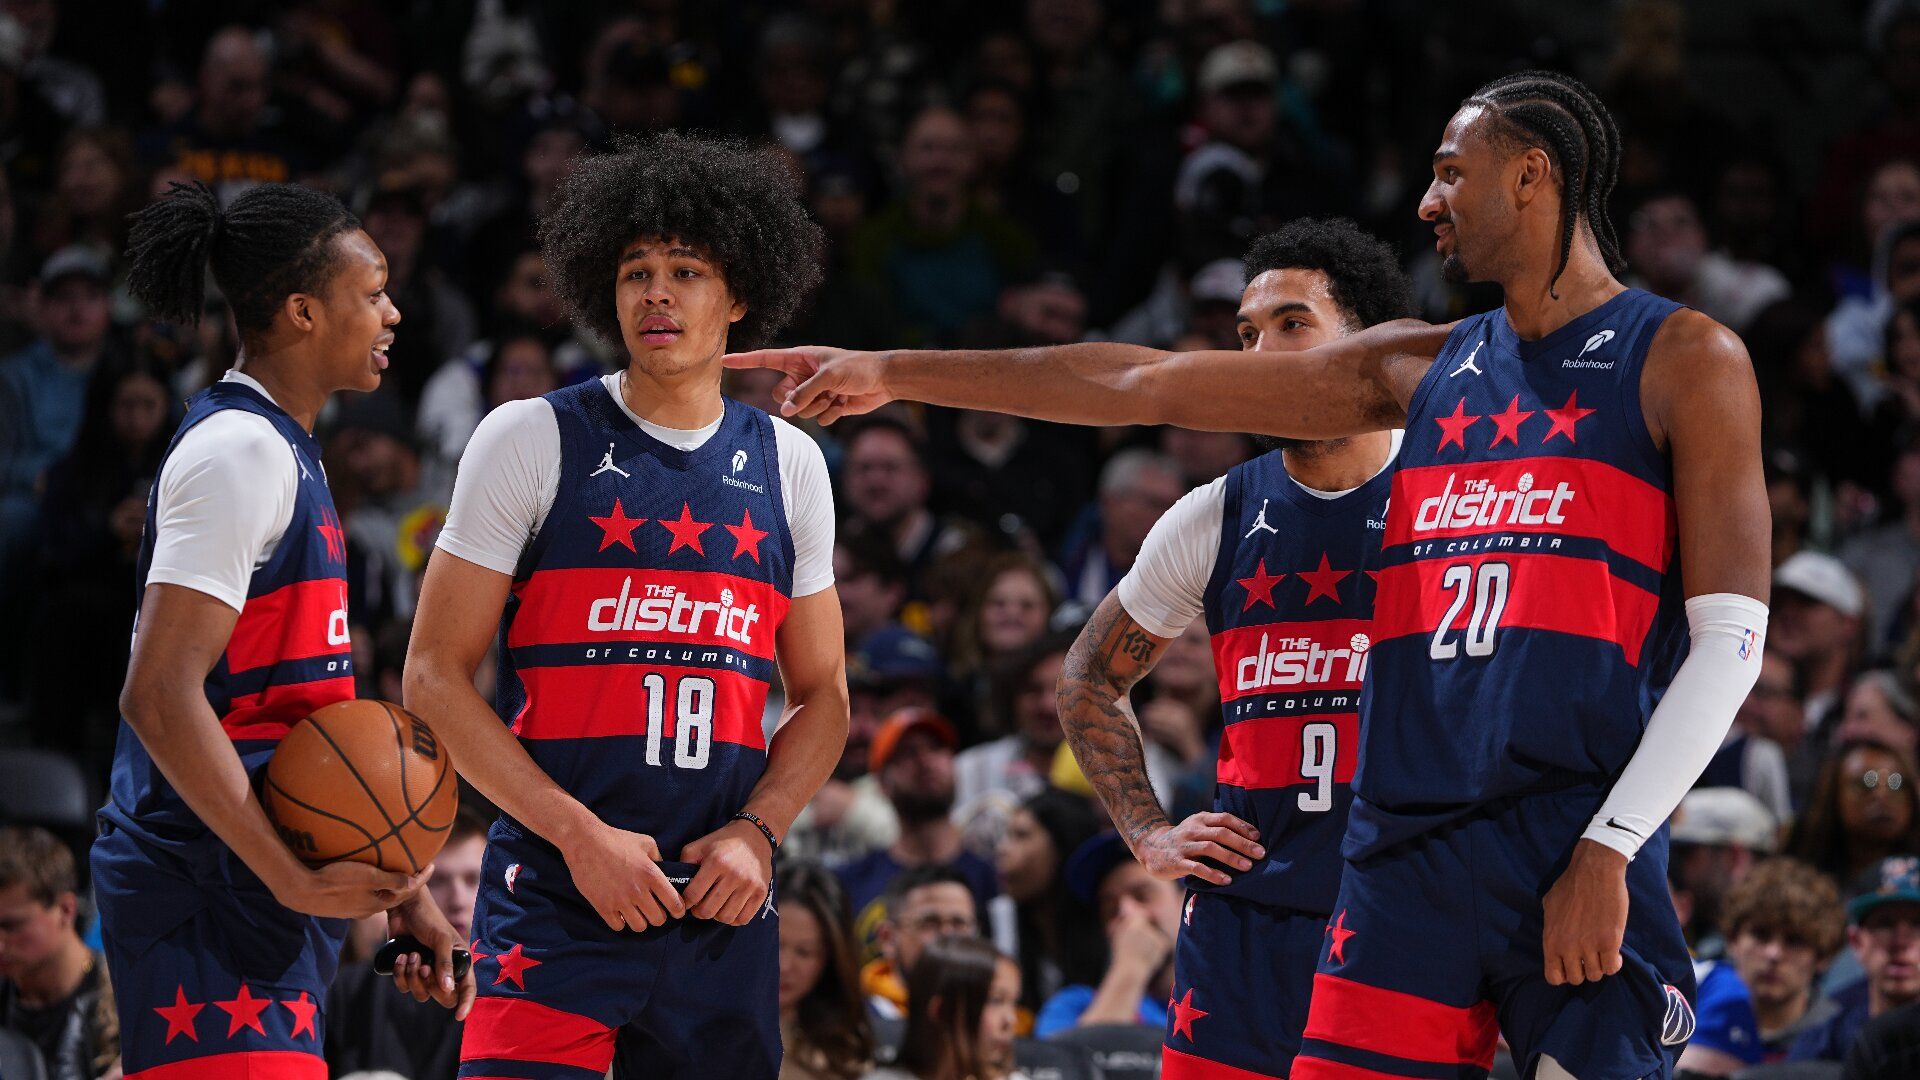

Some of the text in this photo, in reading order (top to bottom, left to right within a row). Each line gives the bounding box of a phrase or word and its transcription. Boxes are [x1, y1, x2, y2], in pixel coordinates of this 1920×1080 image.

[1561, 358, 1615, 370] Robinhood
[722, 475, 764, 494] Robinhood
[1464, 479, 1489, 493] THE
[1413, 472, 1575, 532] district
[1413, 536, 1562, 556] OF COLUMBIA
[644, 584, 677, 598] THE
[587, 575, 761, 645] district
[1429, 562, 1510, 660] 20
[1279, 638, 1311, 650] THE
[327, 660, 349, 672] OF
[586, 647, 748, 670] OF COLUMBIA
[1236, 697, 1360, 715] OF COLUM
[642, 673, 715, 770] 18
[1297, 723, 1336, 812] 9
